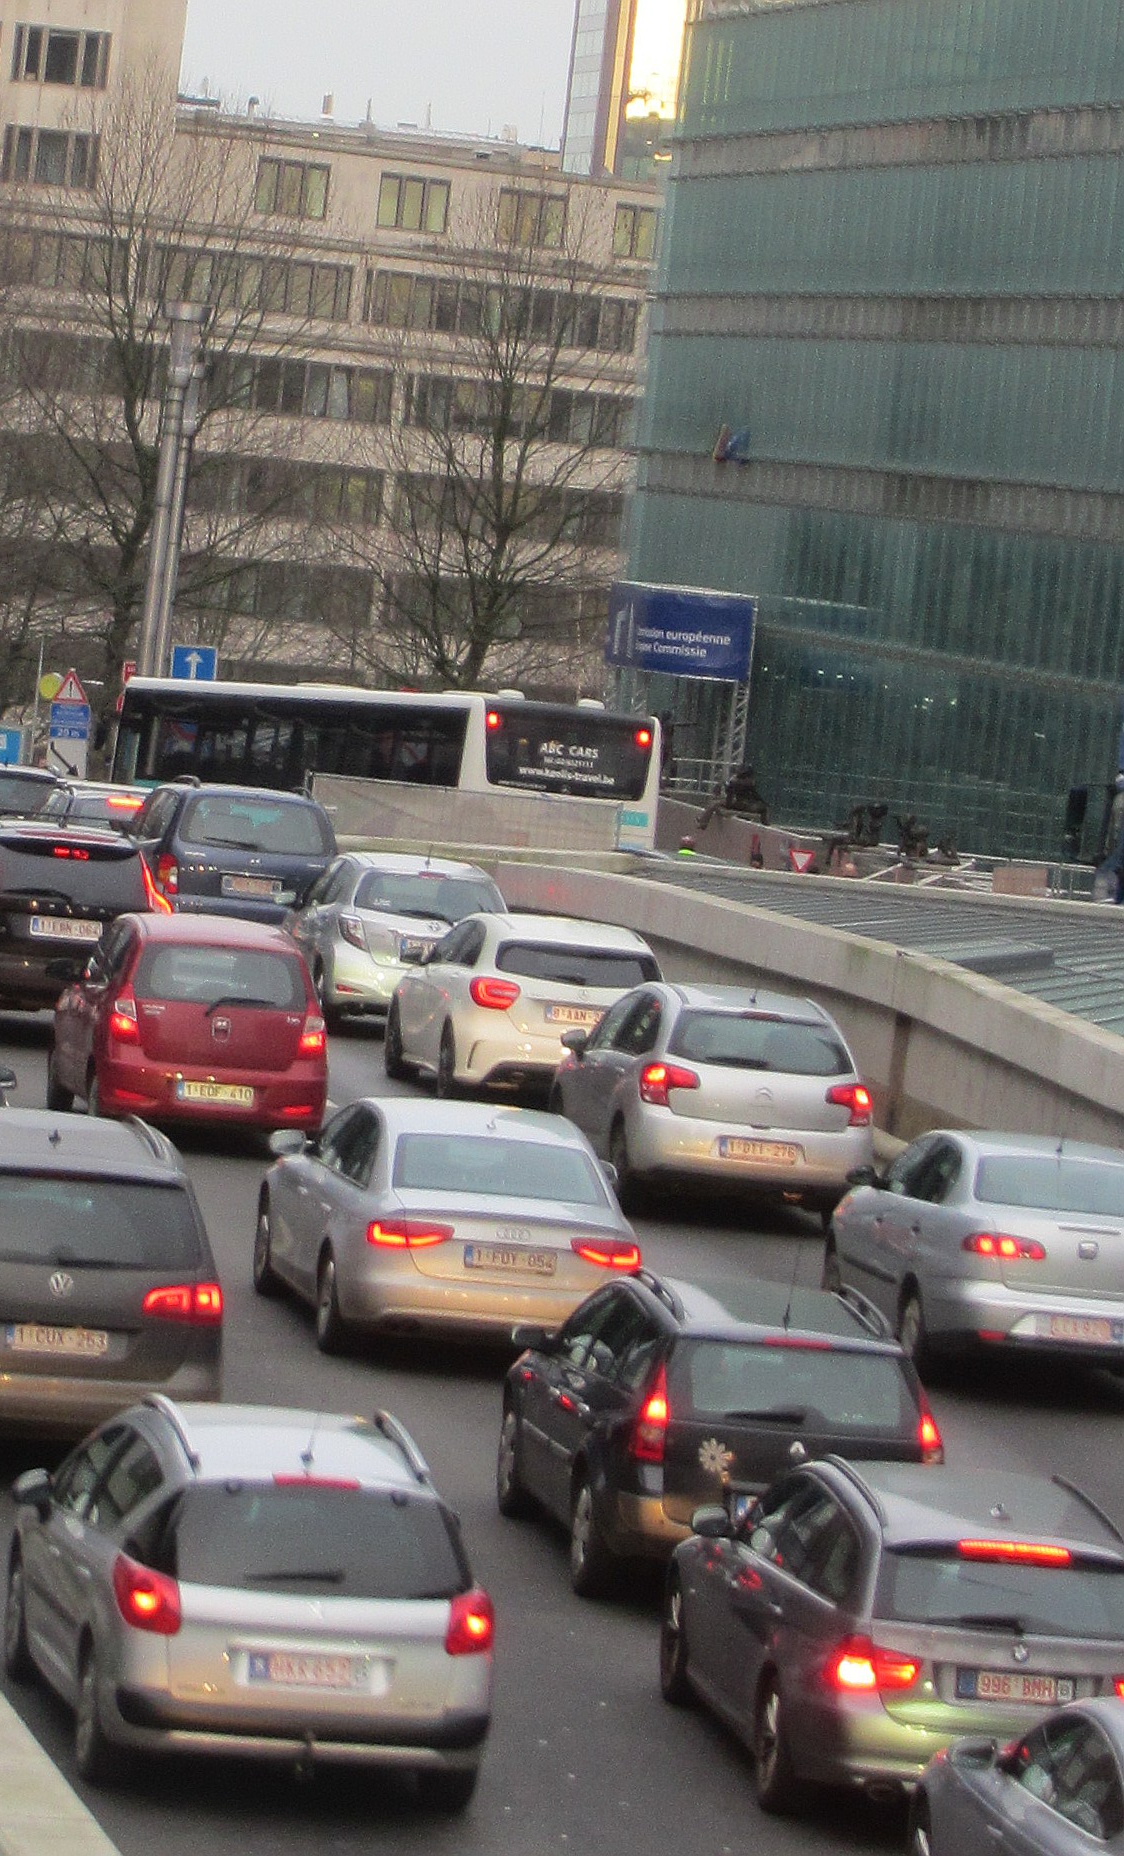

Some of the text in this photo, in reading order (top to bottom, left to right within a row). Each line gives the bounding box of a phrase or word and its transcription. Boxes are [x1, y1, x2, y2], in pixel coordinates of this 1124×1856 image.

[666, 629, 732, 646] européenne
[540, 741, 599, 759] ABC CARS
